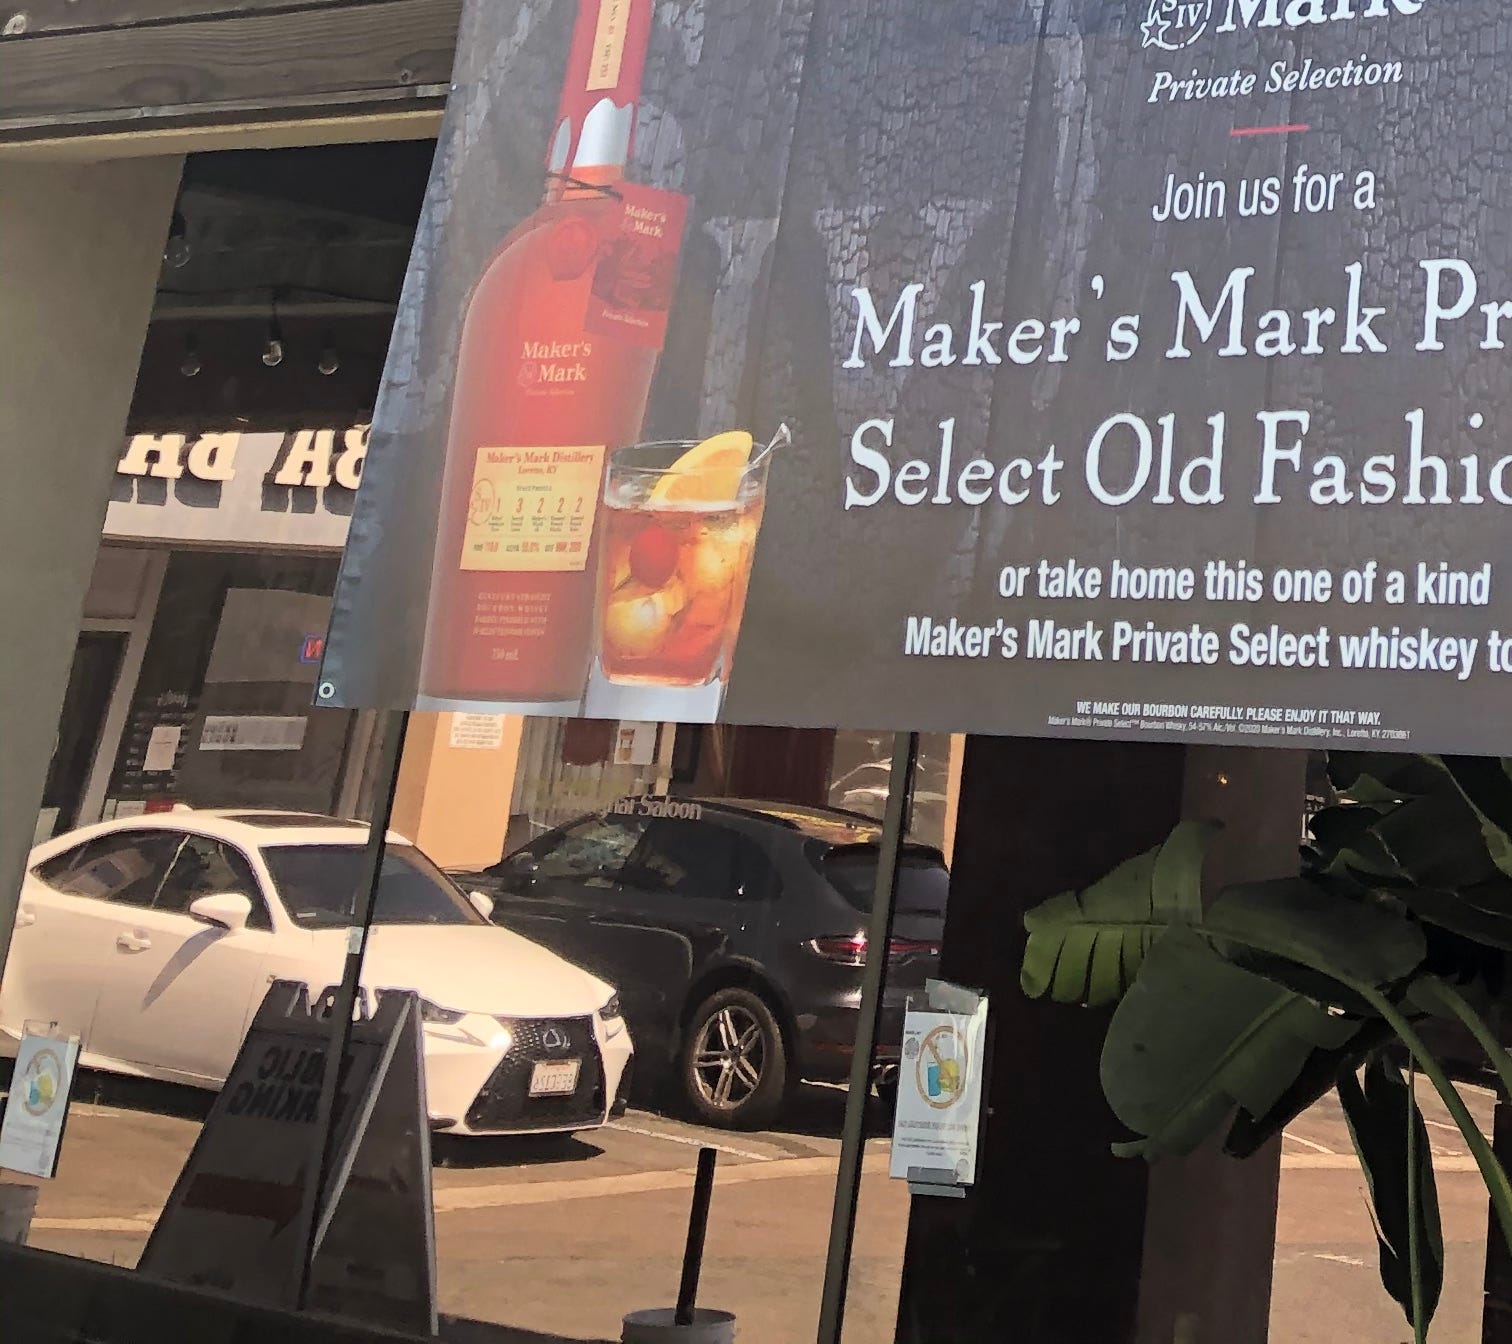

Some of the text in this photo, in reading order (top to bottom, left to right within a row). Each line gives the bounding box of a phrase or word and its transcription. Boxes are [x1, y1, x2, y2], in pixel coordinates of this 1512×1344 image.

[1148, 53, 1404, 103] Private Selection
[1152, 163, 1376, 222] Join us for a
[841, 274, 1141, 369] Maker's
[1164, 265, 1389, 359] Mark
[520, 340, 593, 360] Maker's
[537, 363, 588, 383] Mark
[843, 416, 1065, 511] Select
[1085, 411, 1226, 506] Old
[999, 559, 1492, 606] or take home this one of a kind
[904, 616, 1019, 659] Maker's
[1026, 618, 1104, 662] Mark
[1112, 620, 1220, 664] Private
[1229, 623, 1331, 668] Select
[1338, 625, 1480, 681] whiskey
[1076, 701, 1091, 714] WE
[1093, 701, 1121, 716] MAKE
[1122, 702, 1141, 717] OUR
[1143, 703, 1188, 718] BOURBON
[1246, 707, 1283, 722] PLEASE
[1284, 709, 1317, 724] ENJOY
[1318, 710, 1328, 724] IT
[1330, 710, 1356, 725] THAT
